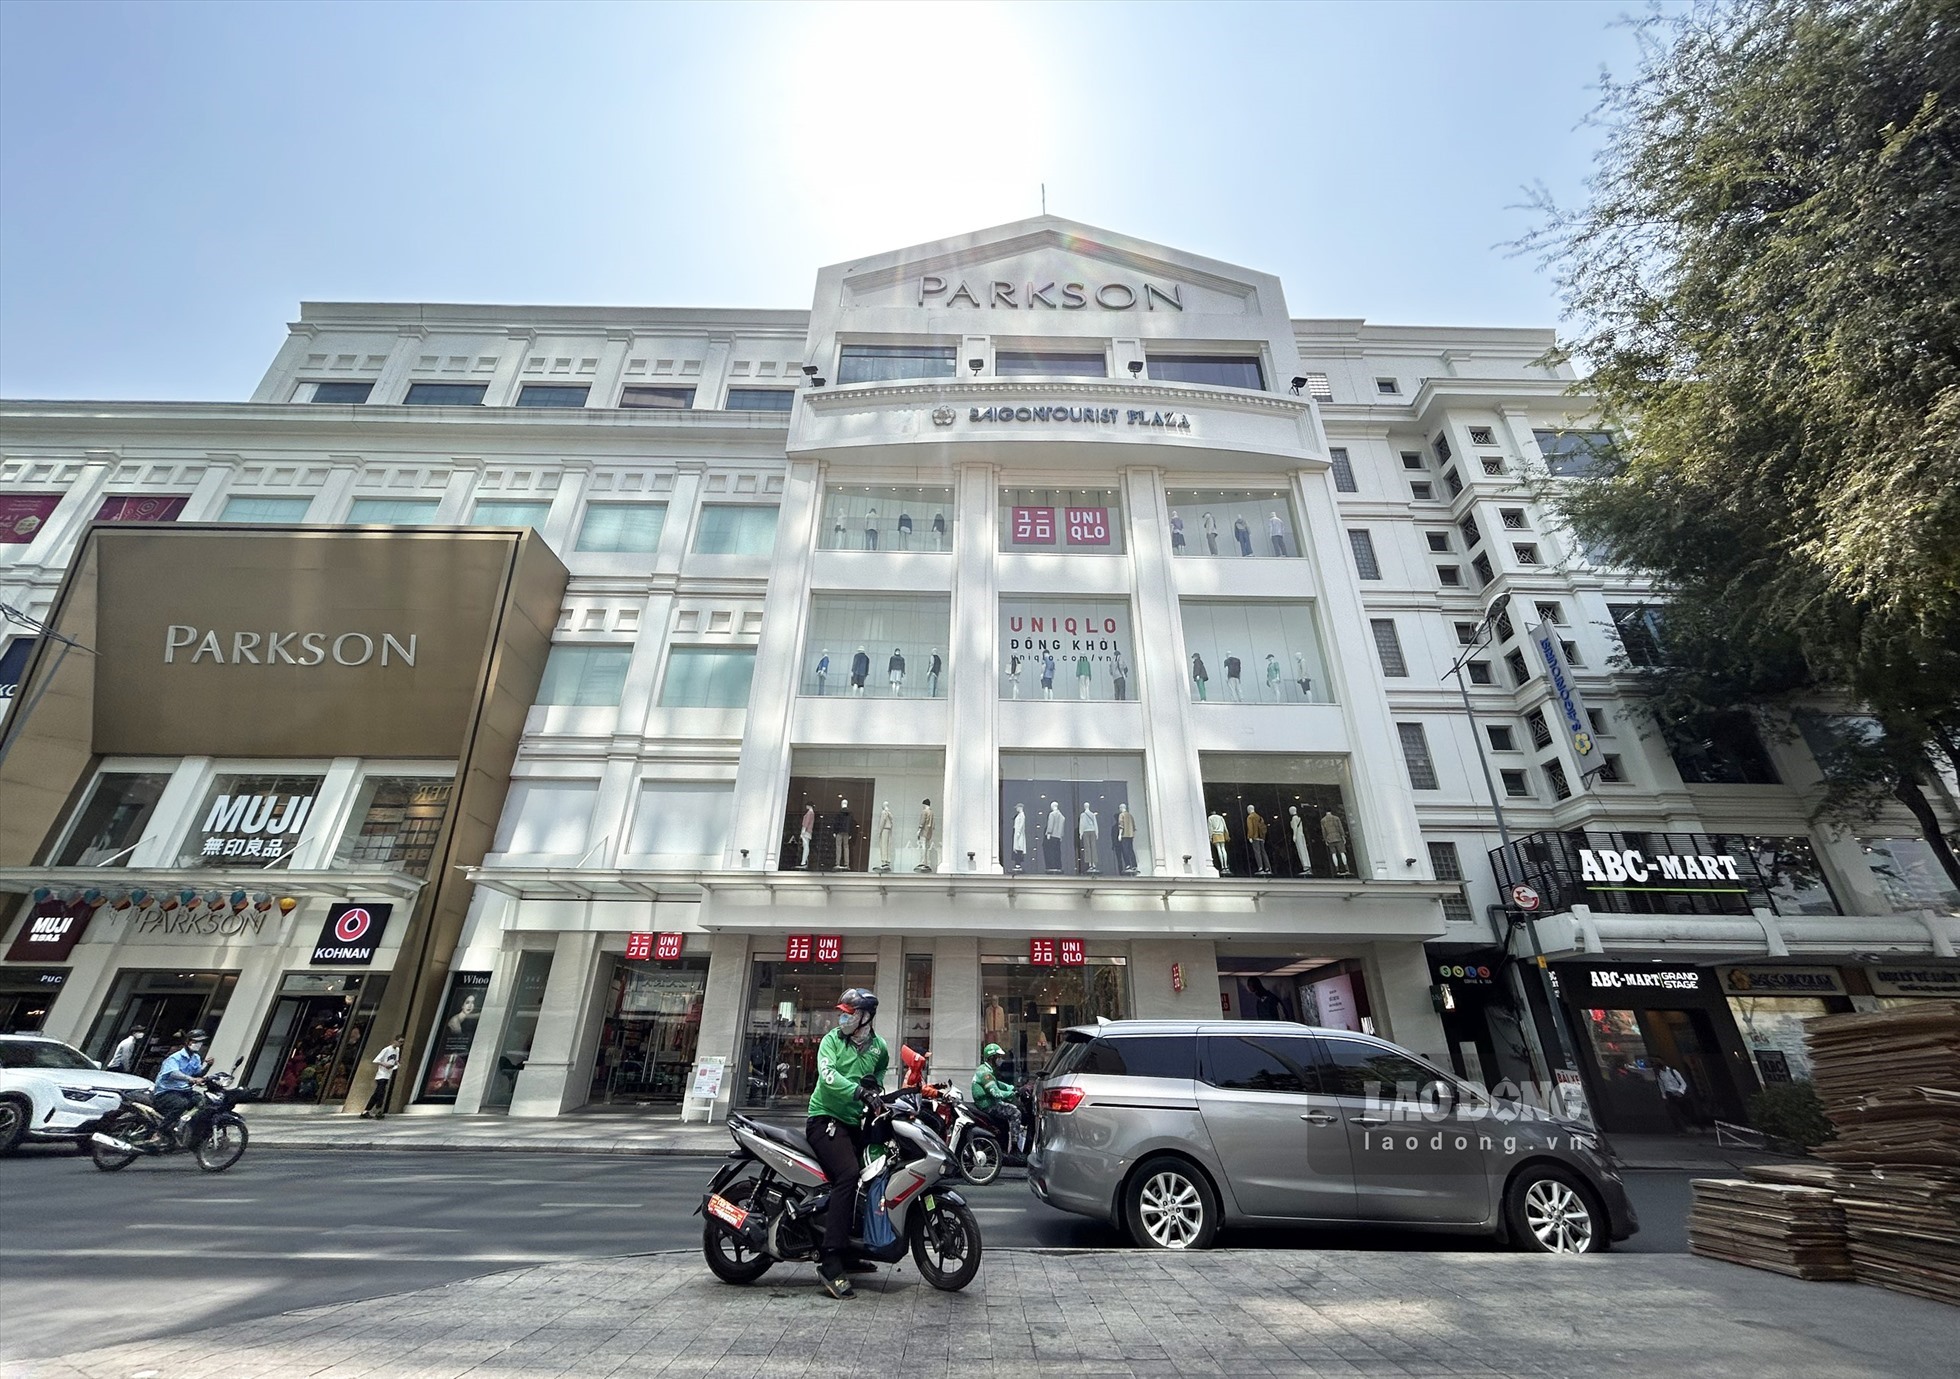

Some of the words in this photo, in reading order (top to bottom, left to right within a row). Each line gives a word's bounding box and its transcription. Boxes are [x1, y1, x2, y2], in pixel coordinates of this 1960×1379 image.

[918, 276, 1183, 311] PARKSON
[969, 407, 1119, 424] SAIGONTOURIST
[1126, 409, 1191, 428] PLAZA
[1070, 511, 1101, 524] UNI
[1071, 526, 1105, 540] QLO
[1010, 617, 1116, 636] UNIQLO
[164, 625, 417, 667] PARKSON
[201, 794, 313, 834] MUJI
[201, 836, 283, 858] 無印良品
[1579, 850, 1739, 882] ABC-MART
[30, 917, 74, 933] MUJI
[139, 910, 267, 937] PARKSON
[660, 937, 678, 946] UNI
[820, 939, 837, 948] UNI
[1063, 942, 1080, 951] UNI
[314, 947, 370, 959] KOHNAN
[658, 947, 678, 957] QLO
[818, 949, 837, 960] QLO
[1063, 953, 1082, 963] QLO
[1590, 971, 1661, 988] ABC-MART
[1661, 972, 1698, 981] GRAND
[1665, 981, 1698, 989] STAGE
